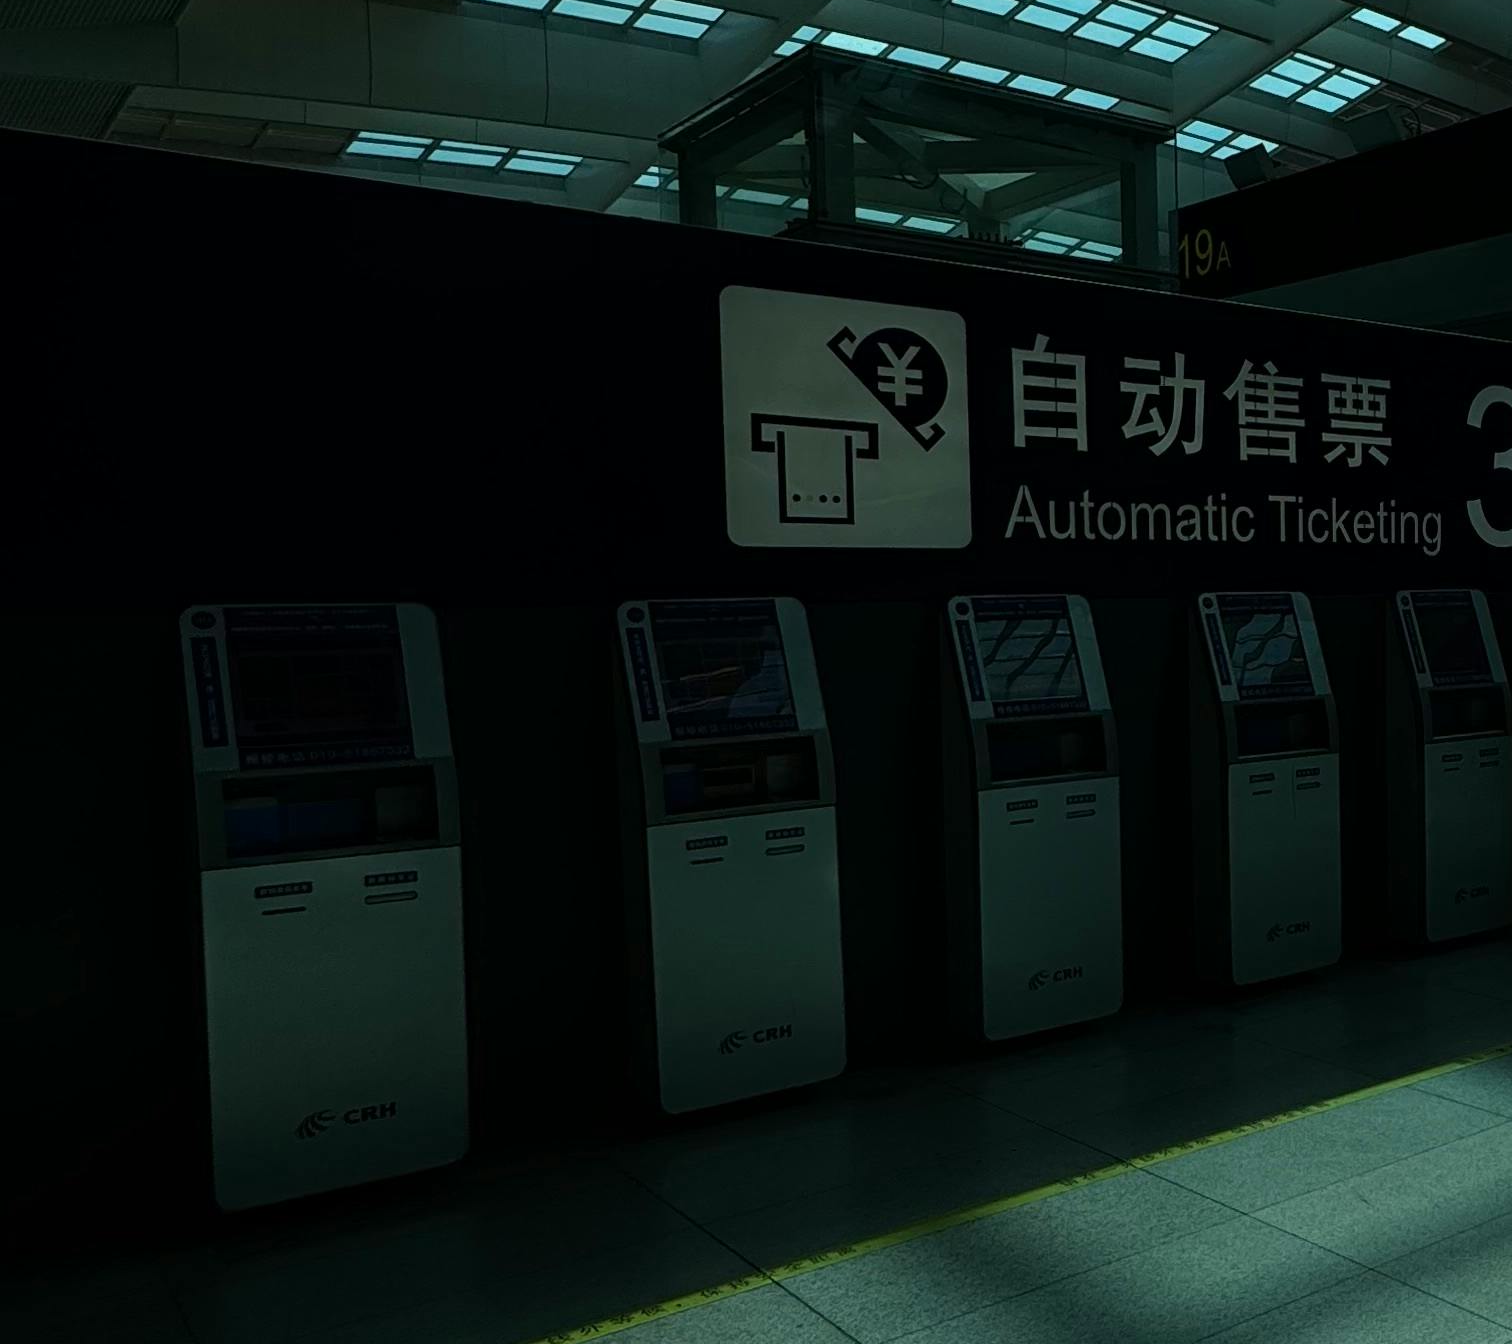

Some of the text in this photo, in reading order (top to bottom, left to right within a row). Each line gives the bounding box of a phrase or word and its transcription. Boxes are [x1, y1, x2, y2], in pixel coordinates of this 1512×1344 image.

[1177, 228, 1233, 280] 19A
[1011, 333, 1392, 467] 自动售票
[1004, 484, 1442, 557] Automatic Ticketing
[1053, 966, 1084, 982] CRH
[753, 1024, 793, 1044] CRH
[344, 1102, 397, 1126] CRH
